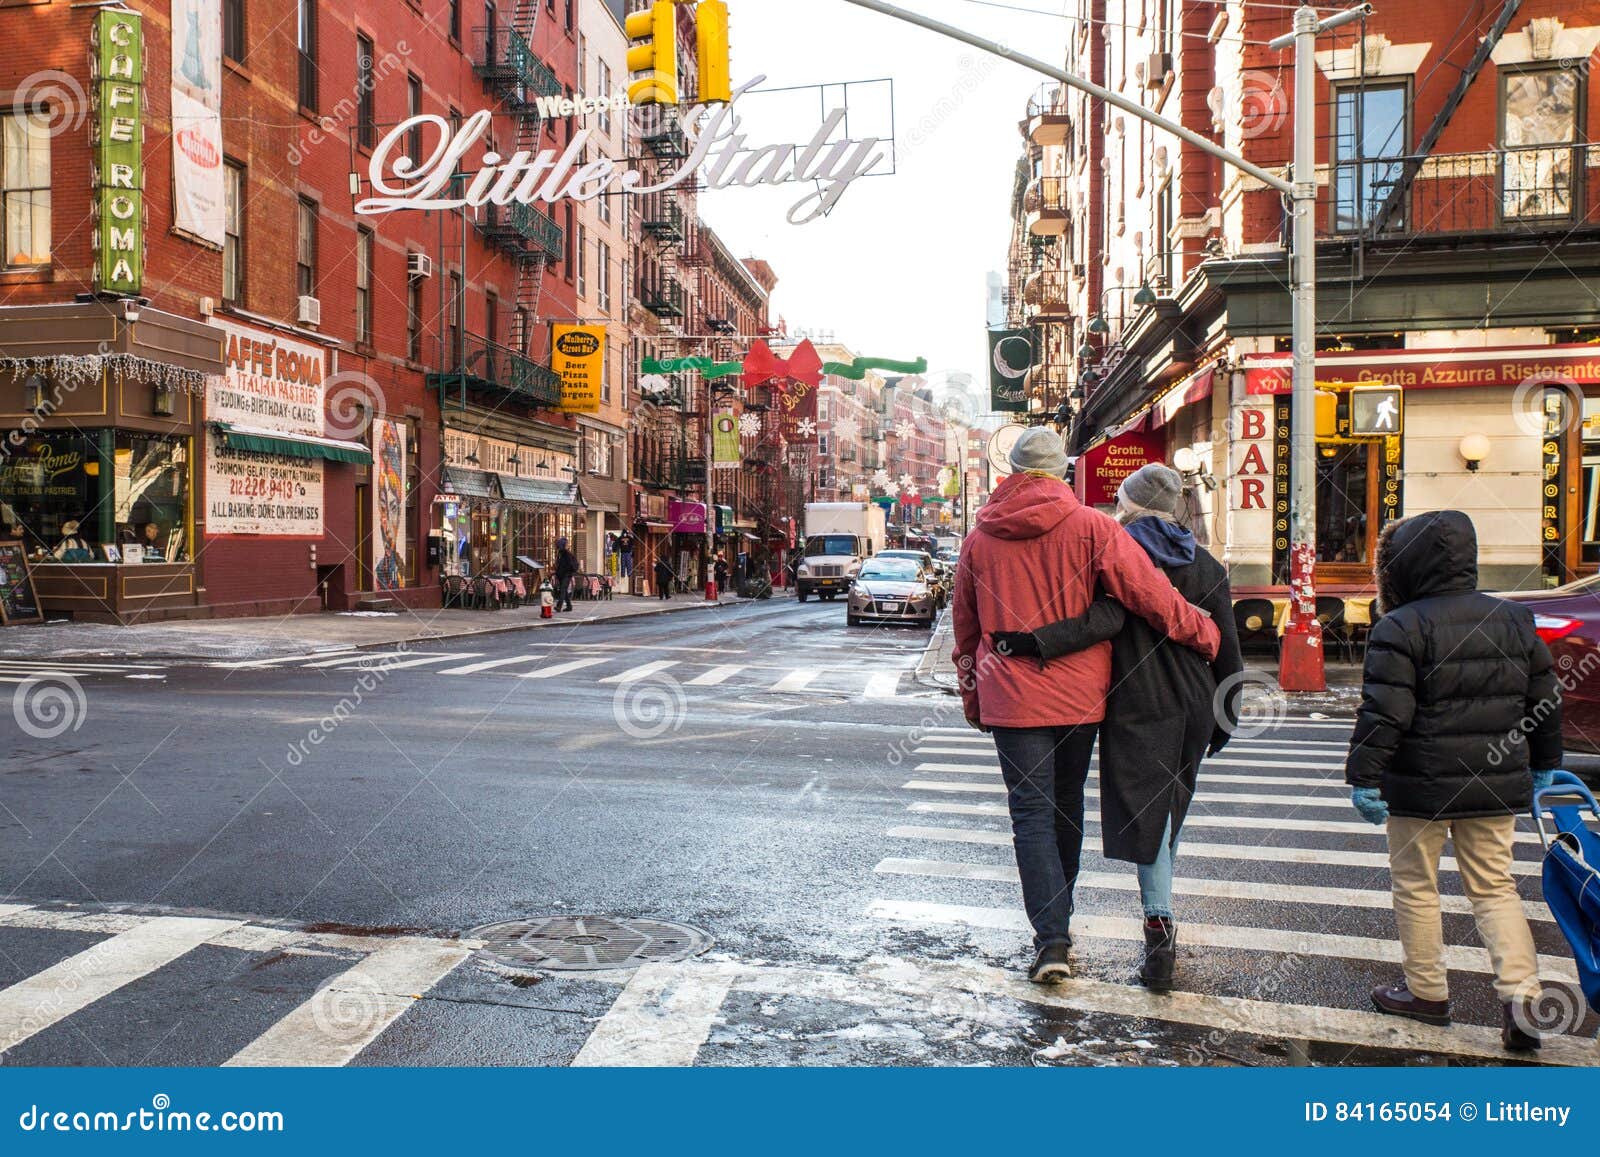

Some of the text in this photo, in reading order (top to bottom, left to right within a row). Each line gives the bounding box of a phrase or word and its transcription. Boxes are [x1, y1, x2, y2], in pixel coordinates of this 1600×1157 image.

[535, 92, 634, 119] Welcom
[110, 22, 135, 283] CAFE ROMA
[354, 73, 885, 226] Little Italy
[562, 344, 594, 353] Street Bar
[564, 335, 594, 345] Mulberry
[226, 334, 322, 387] AFFE' ROMA
[565, 361, 587, 369] Beer
[562, 371, 588, 379] Pizza
[1358, 369, 1416, 386] Grotta
[1421, 366, 1495, 384] Azzurra
[236, 372, 276, 397] ITALIAN
[278, 382, 318, 404] PASTRIES
[561, 392, 594, 400] urgers
[1108, 445, 1144, 455] Grotta
[1237, 409, 1269, 509] BAR
[37, 444, 80, 481] Roma
[1104, 456, 1148, 466] Azzurra
[1275, 408, 1289, 550] ESPRESSO
[211, 502, 227, 518] ALL
